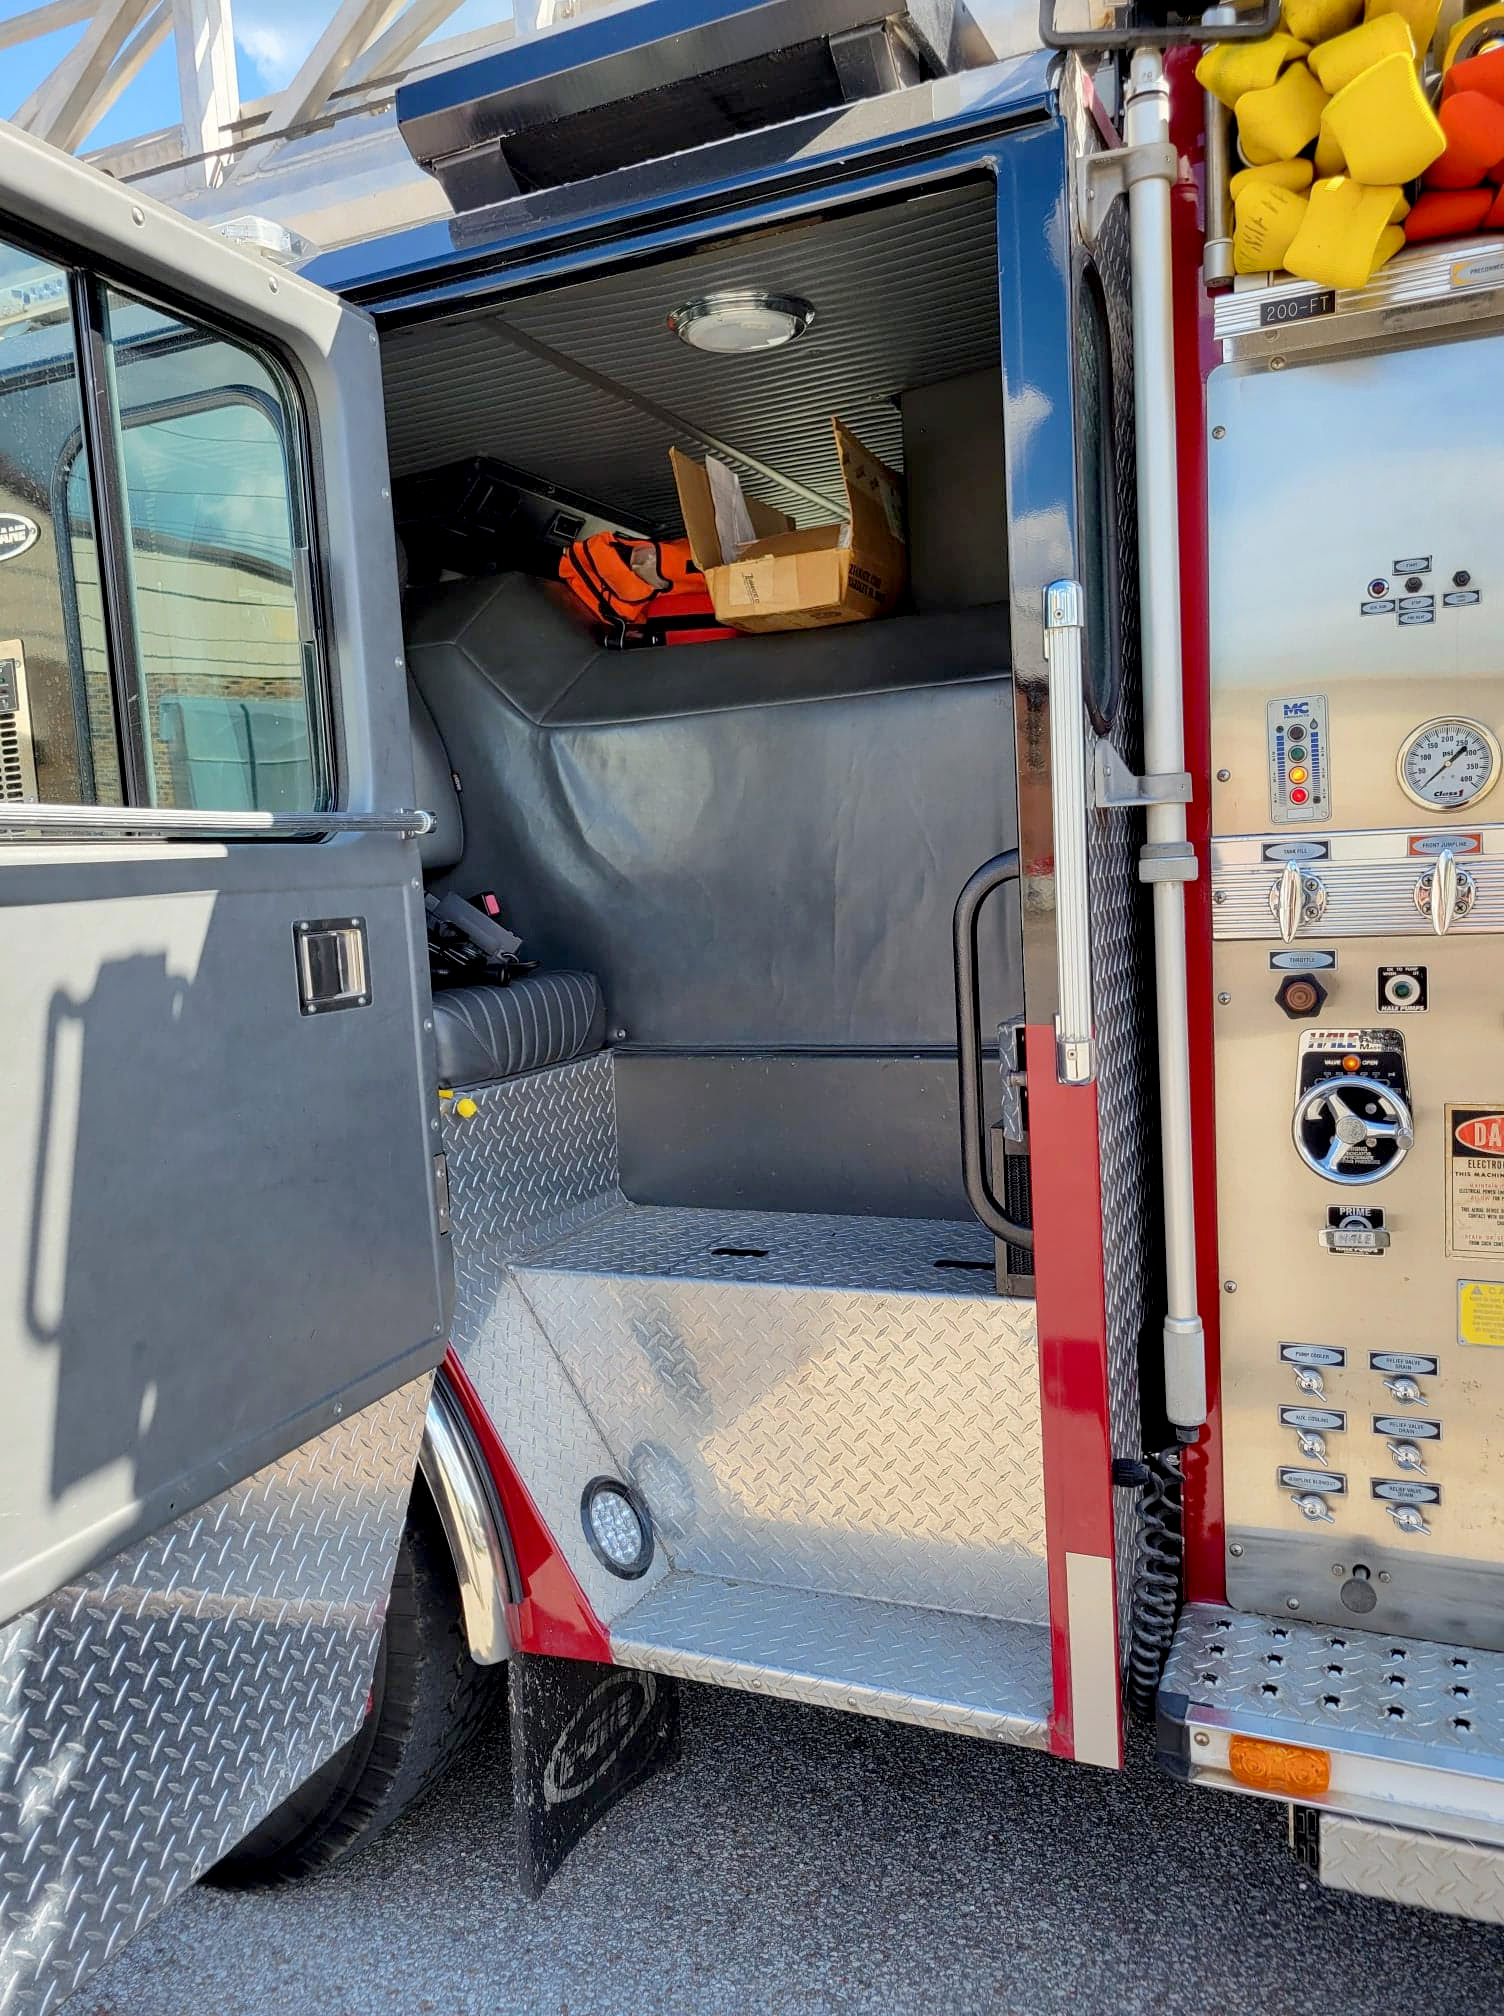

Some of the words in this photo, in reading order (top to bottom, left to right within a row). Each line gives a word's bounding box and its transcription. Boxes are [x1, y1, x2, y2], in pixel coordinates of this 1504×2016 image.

[1266, 295, 1329, 321] 200-FT
[1283, 702, 1309, 716] MC
[1442, 749, 1454, 757] psi
[1468, 1159, 1504, 1169] ELECTRO
[1339, 1207, 1372, 1217] PRIME
